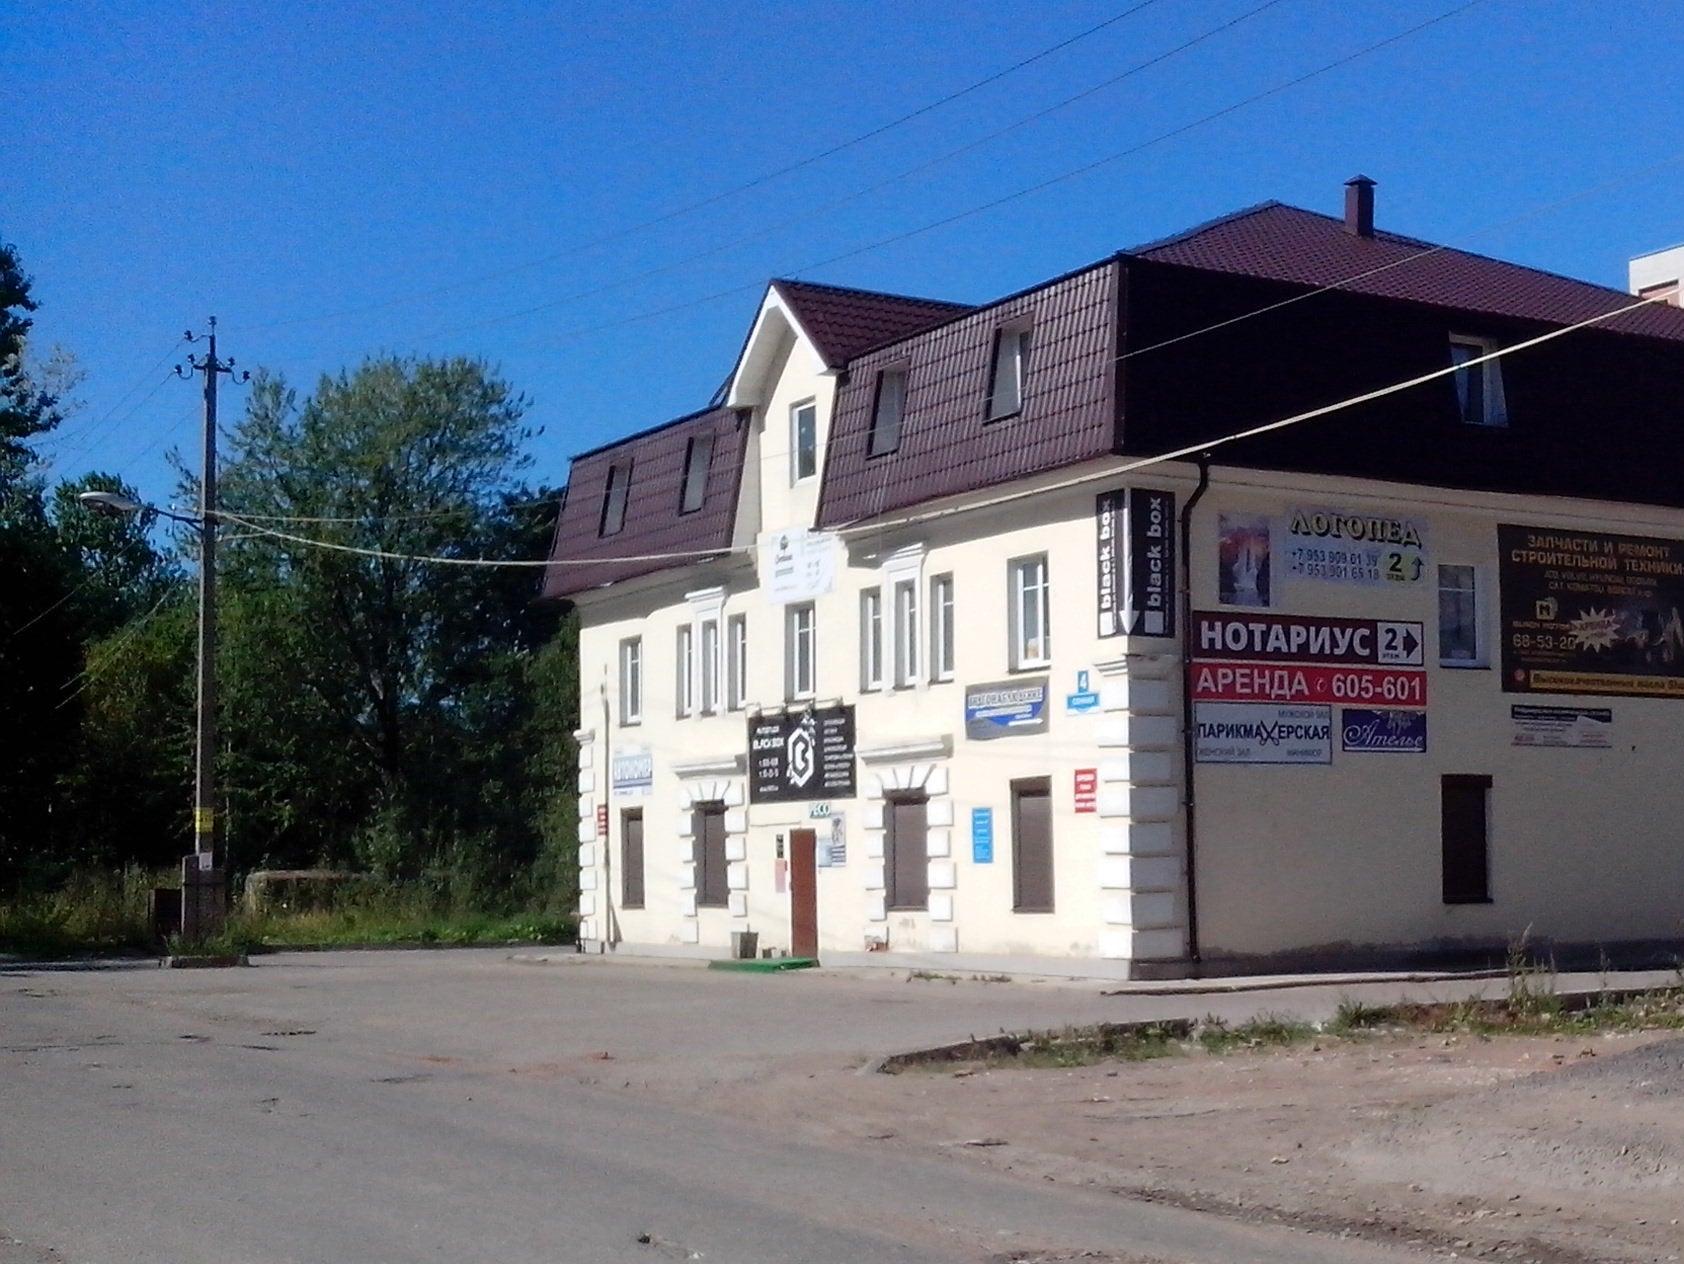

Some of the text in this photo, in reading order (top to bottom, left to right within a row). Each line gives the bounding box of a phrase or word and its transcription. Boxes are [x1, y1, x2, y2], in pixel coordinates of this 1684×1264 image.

[1291, 510, 1422, 549] ЛОГОПЕД
[1100, 499, 1112, 609] black box
[1147, 497, 1161, 607] black box
[1527, 534, 1671, 559] ЗАПЧАСТИ И РЕМОНТ
[1389, 553, 1402, 572] 2
[1511, 549, 1617, 571] СТРОИТЕЛЬНОЙ
[1200, 620, 1371, 656] НОТАРИУС
[1384, 628, 1398, 651] 2
[1079, 673, 1088, 690] 4
[1197, 668, 1421, 701] АРЕНДА 605-601
[1198, 721, 1330, 745] ПАРИКМАХЕРСКАЯ
